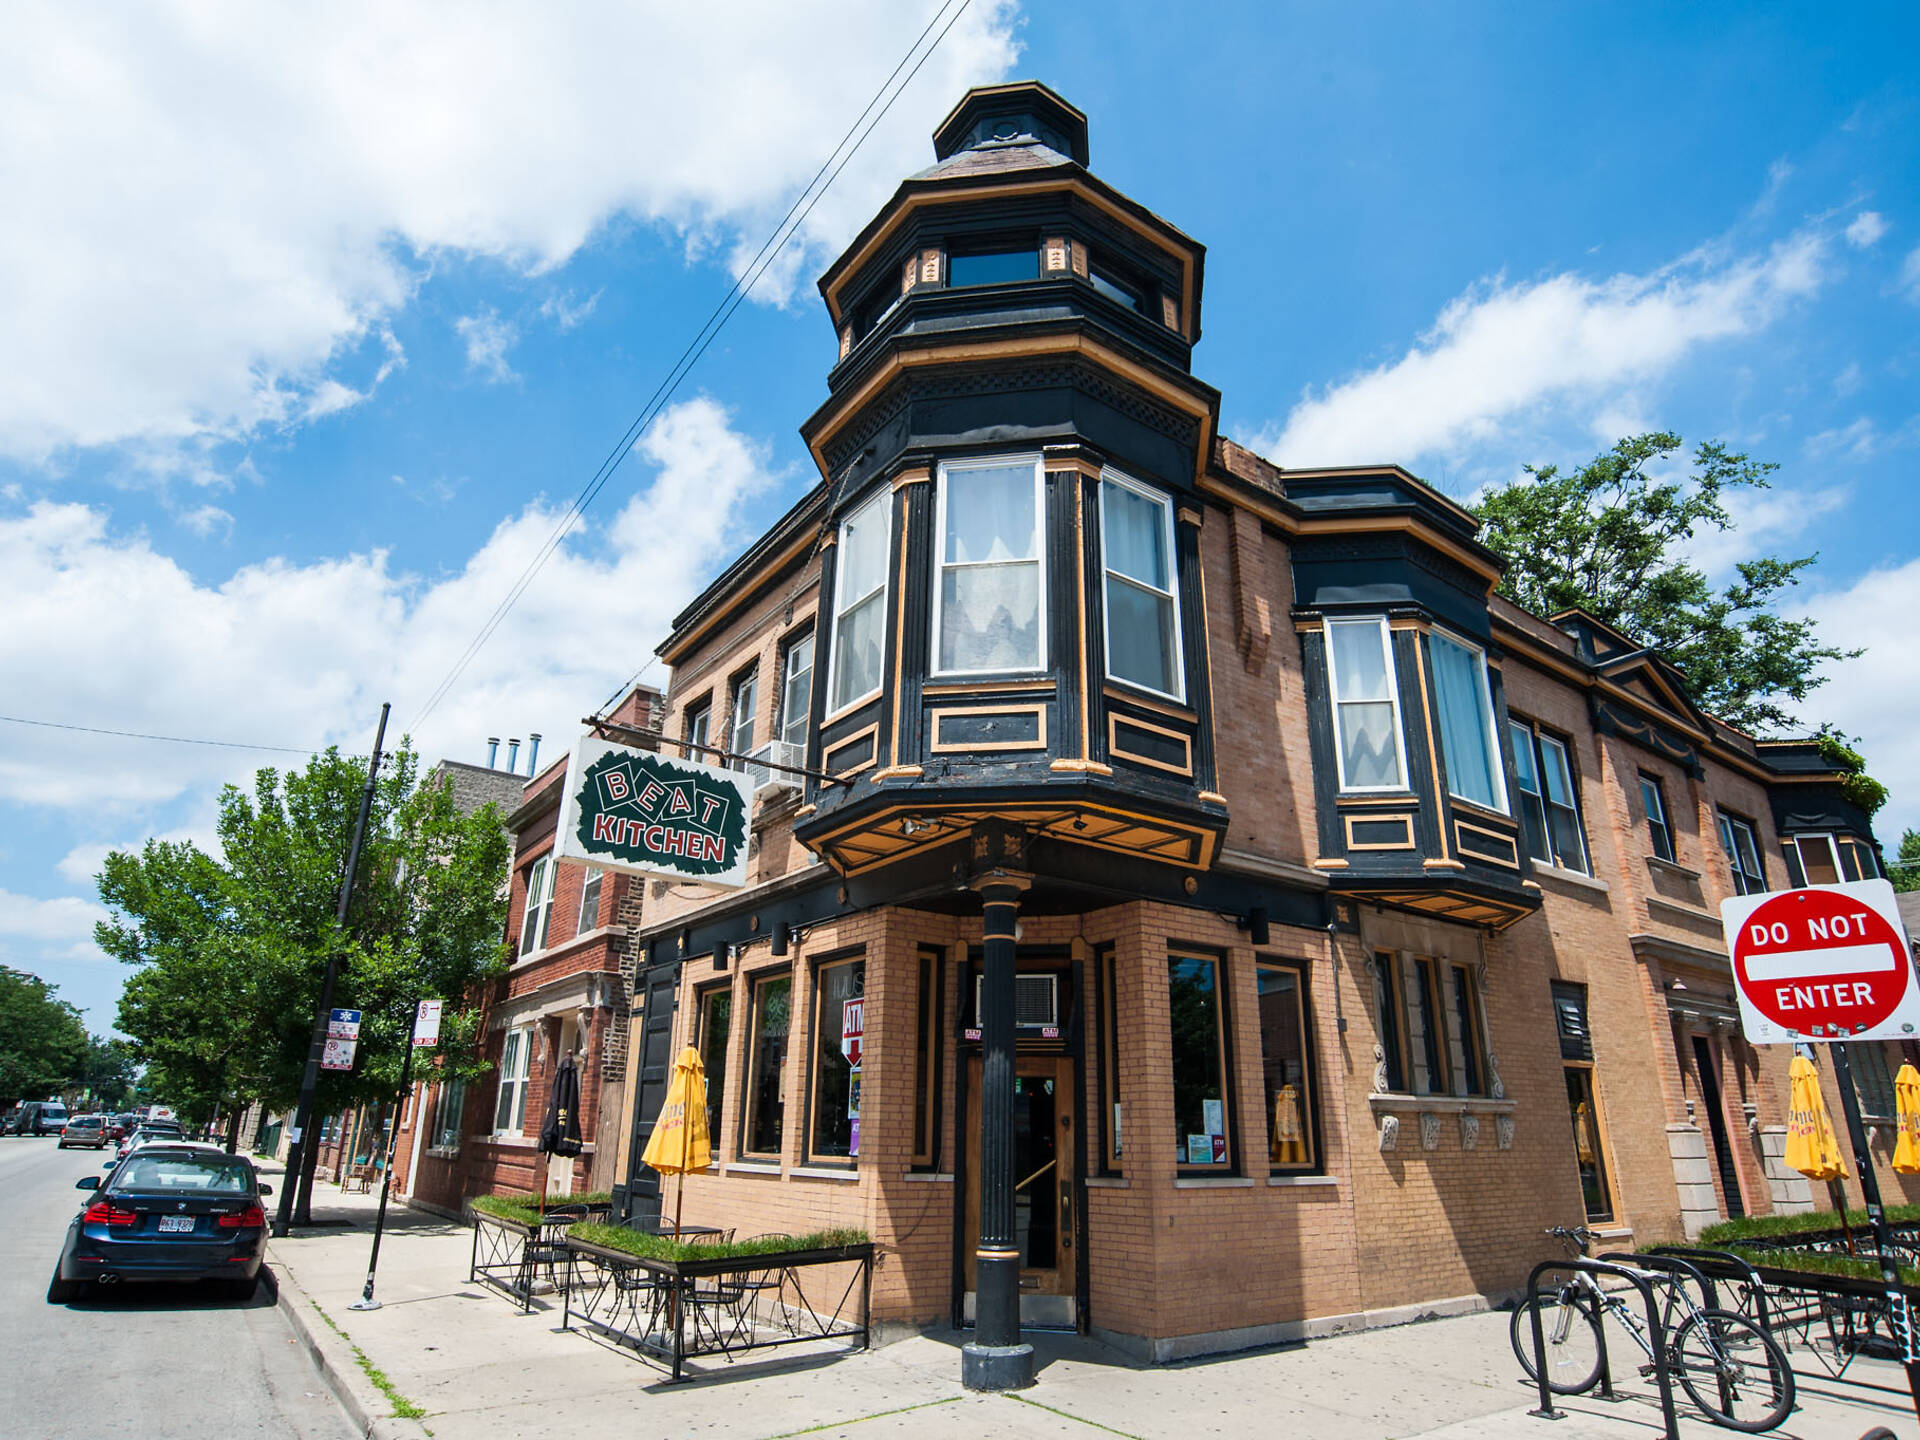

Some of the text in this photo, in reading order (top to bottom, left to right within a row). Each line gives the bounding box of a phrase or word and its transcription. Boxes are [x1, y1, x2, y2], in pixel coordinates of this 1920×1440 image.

[605, 772, 719, 824] BEAT
[593, 813, 726, 862] KITCHEN
[1750, 913, 1867, 947] DO NOT
[1775, 982, 1875, 1011] ENTER
